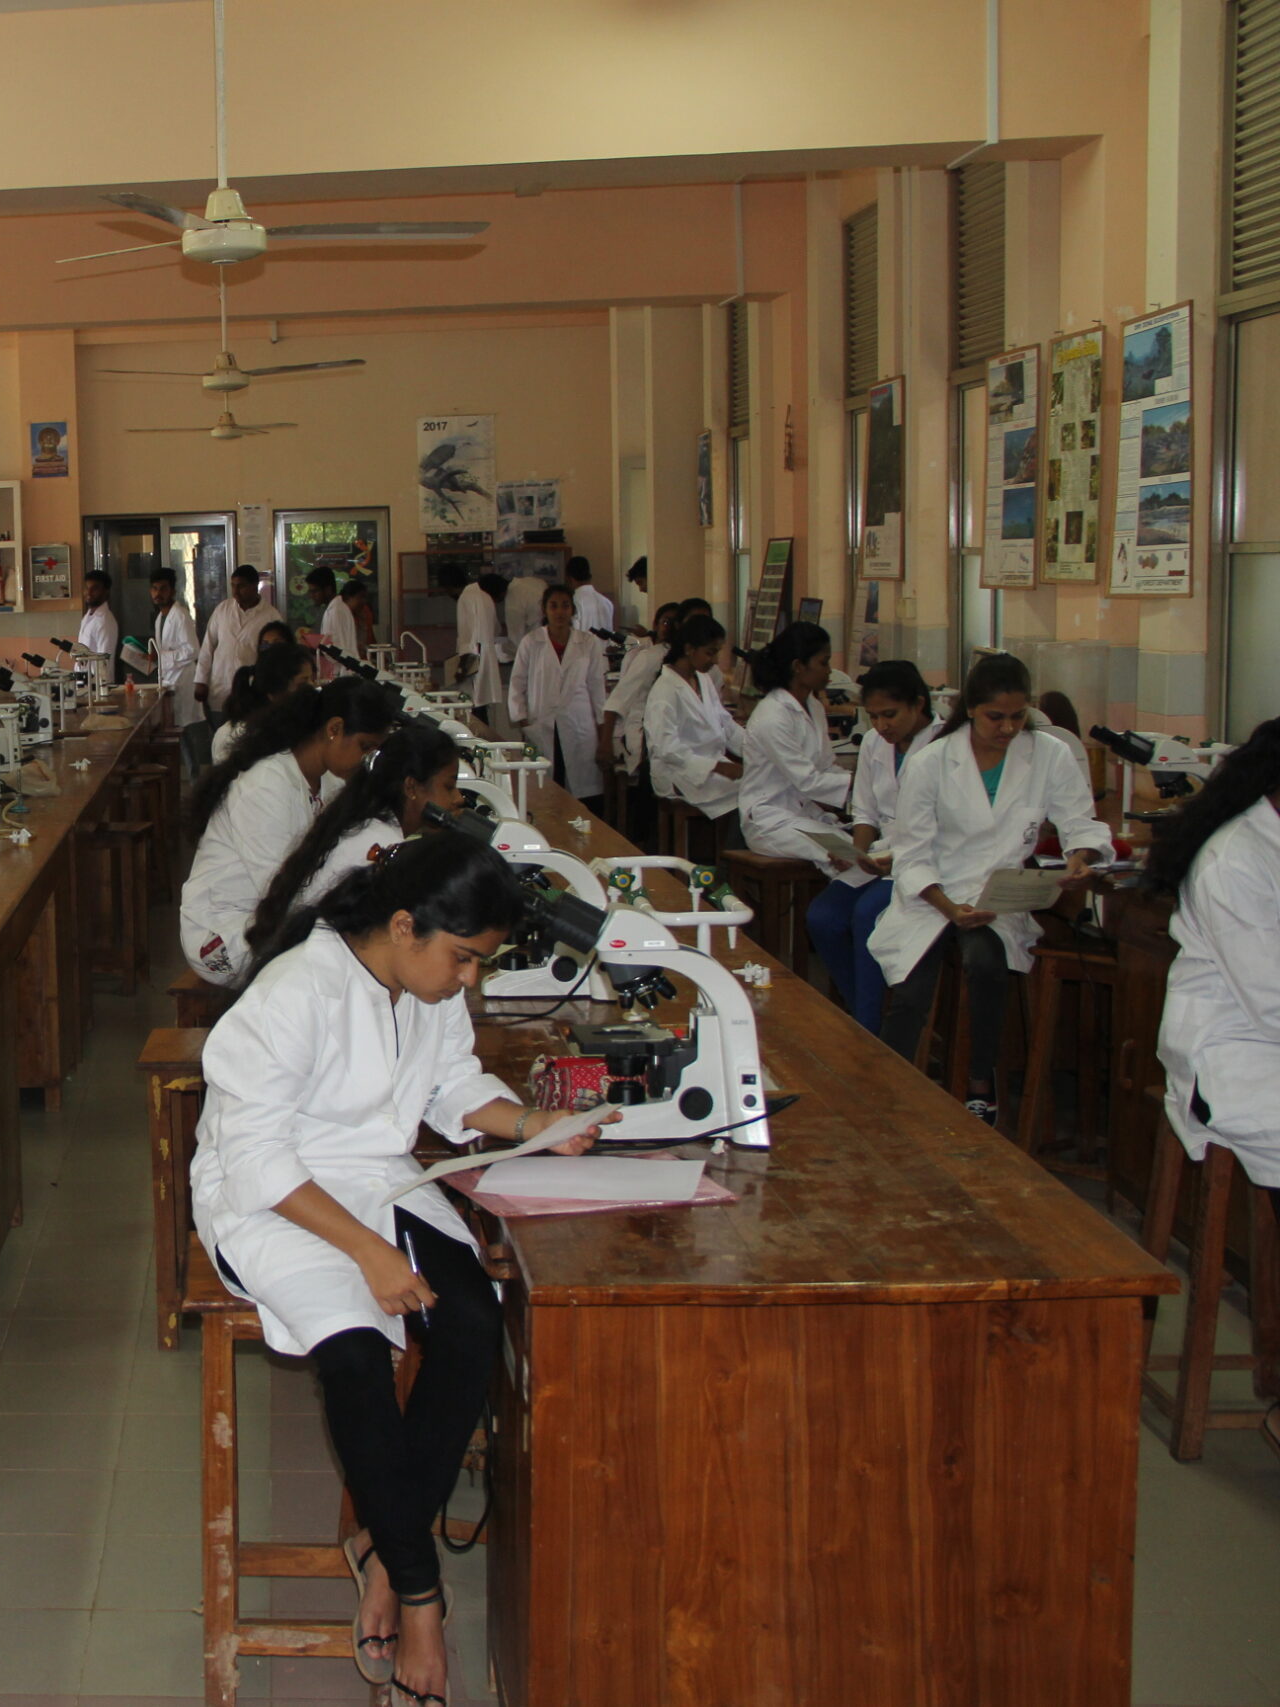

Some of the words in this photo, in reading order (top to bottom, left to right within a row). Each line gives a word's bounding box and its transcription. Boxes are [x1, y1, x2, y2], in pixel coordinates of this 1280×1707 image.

[423, 421, 448, 432] 2017
[35, 574, 54, 583] FIRST
[54, 574, 66, 583] AID
